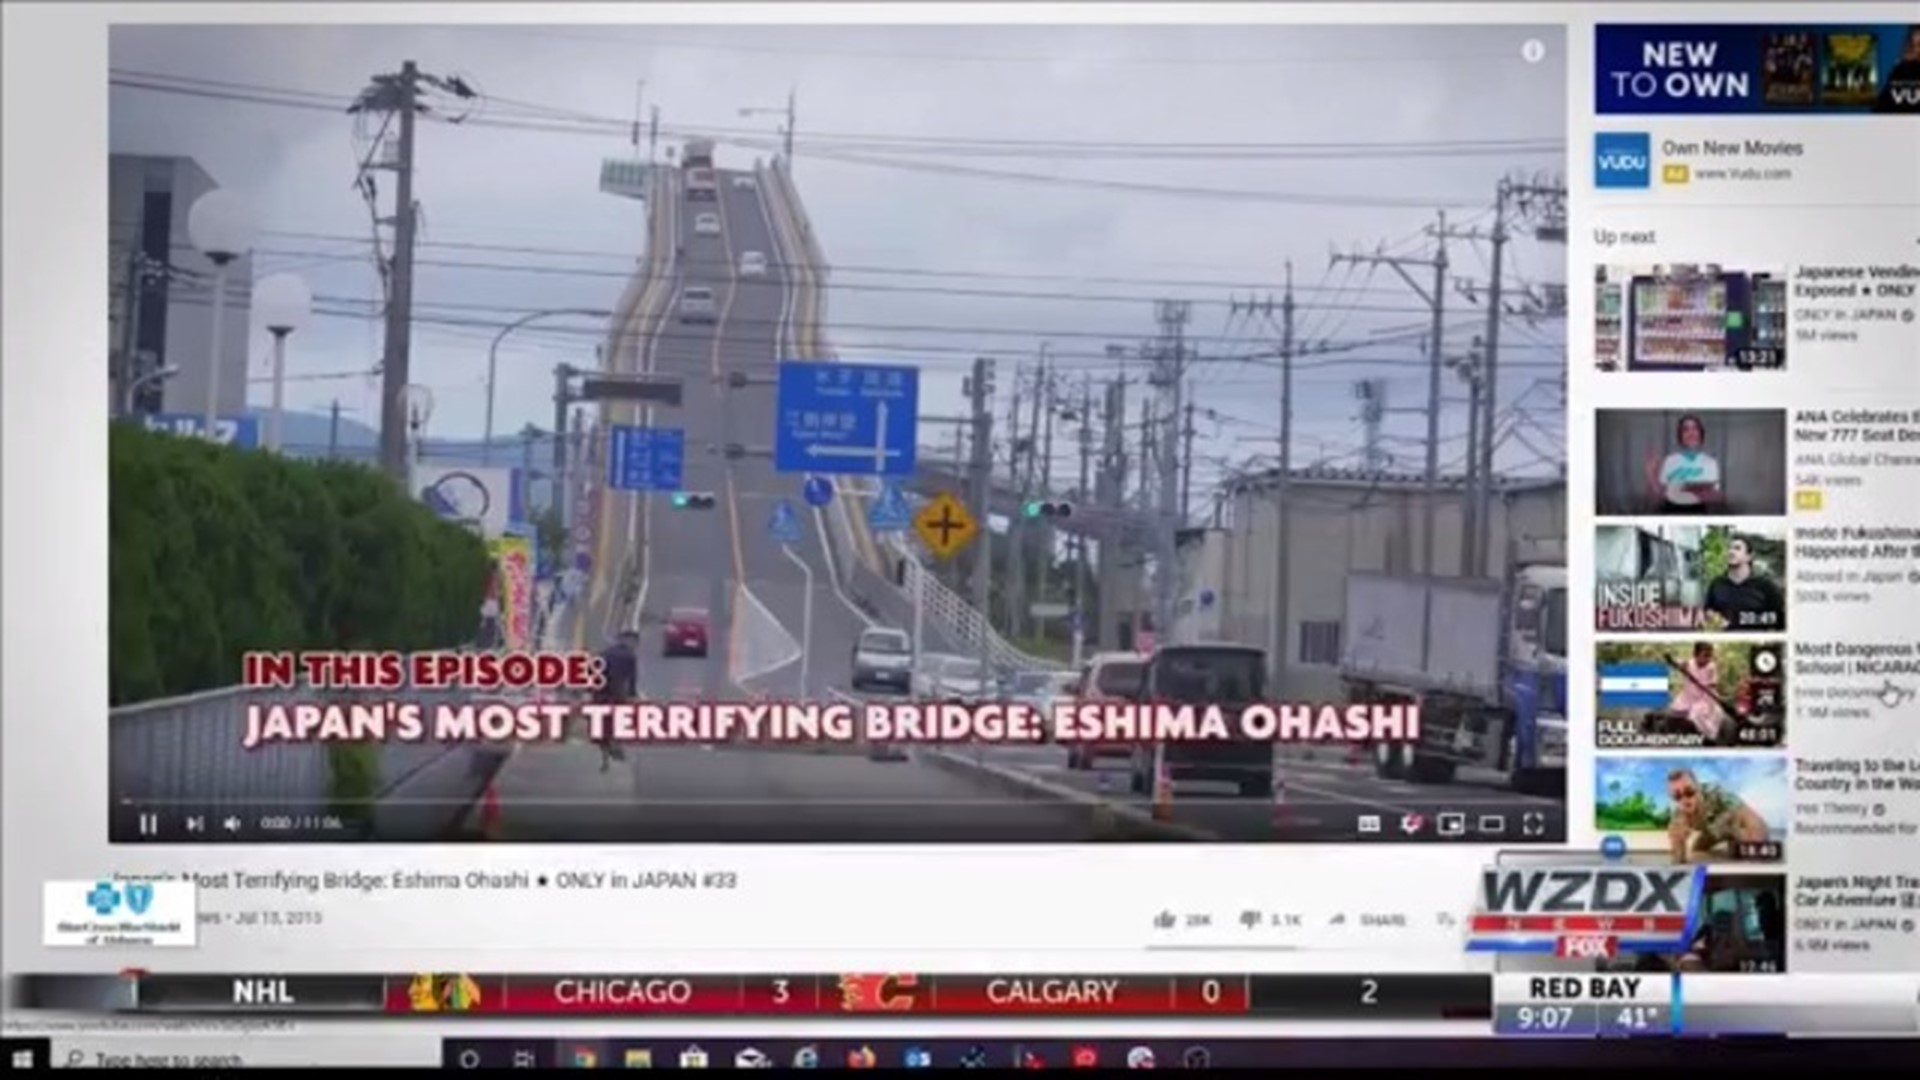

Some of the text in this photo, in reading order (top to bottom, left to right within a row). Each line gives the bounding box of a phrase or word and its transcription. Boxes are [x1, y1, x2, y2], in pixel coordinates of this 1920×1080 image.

[1643, 42, 1717, 67] NEW
[1611, 71, 1657, 97] TO
[1665, 71, 1749, 97] OWN
[1662, 140, 1804, 156] Own New Movies
[1594, 229, 1656, 246] Up next
[1796, 265, 1863, 281] Japanese
[1796, 283, 1857, 299] Exposed
[1796, 410, 1828, 423] ANA
[1832, 409, 1909, 423] Celebrates
[1795, 429, 1827, 442] New
[1831, 429, 1858, 442] 777
[1862, 429, 1894, 442] Seat
[1796, 544, 1868, 561] Happened
[1872, 544, 1908, 558] After
[1599, 583, 1660, 607] INSIDE
[1796, 642, 1913, 659] Most Dangerous
[1796, 758, 1860, 776] Traveling
[1864, 758, 1879, 773] to
[1883, 758, 1905, 773] the
[1796, 776, 1850, 794] Country
[1855, 777, 1869, 791] in
[1872, 777, 1895, 791] the
[1795, 821, 1895, 836] Recommended
[233, 870, 320, 894] Terrifying
[323, 871, 386, 893] Bridge:
[392, 871, 461, 889] Eshima
[464, 871, 529, 889] Ohashi
[556, 872, 606, 889] ONLY
[611, 872, 627, 889] in
[632, 872, 697, 889] JAPAN
[702, 872, 737, 889] #33
[1853, 874, 1891, 892] Night
[1795, 892, 1820, 907] Car
[1823, 892, 1896, 907] Adventure
